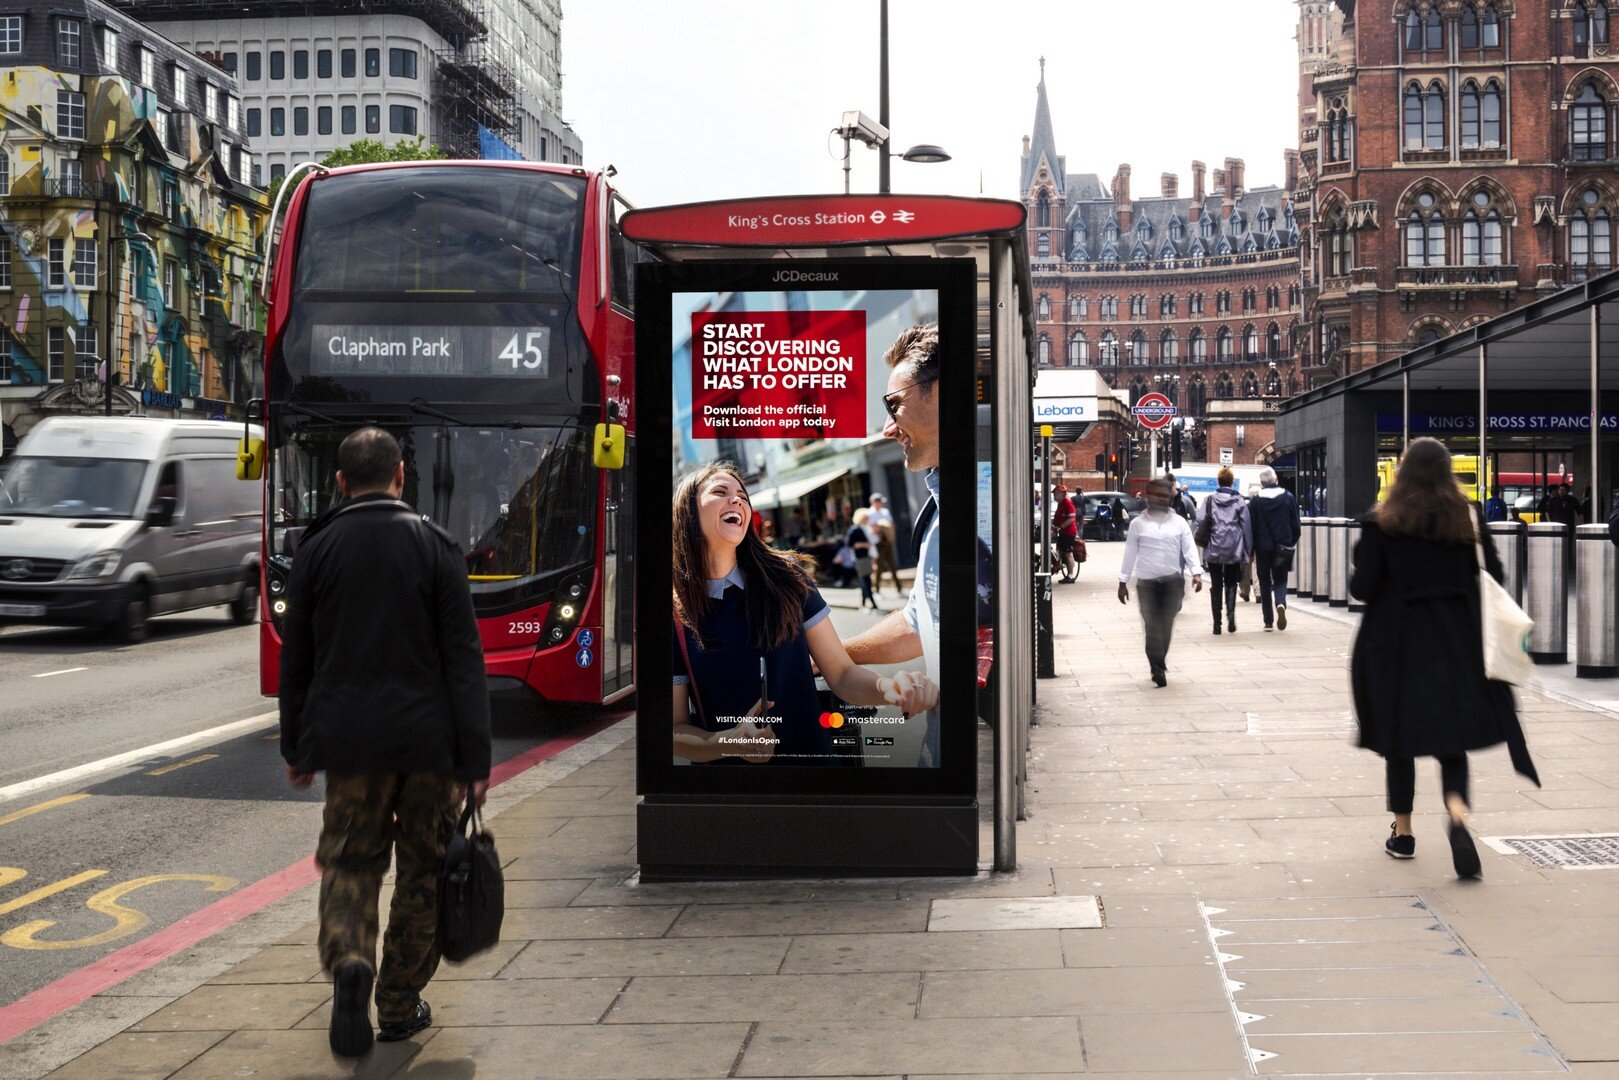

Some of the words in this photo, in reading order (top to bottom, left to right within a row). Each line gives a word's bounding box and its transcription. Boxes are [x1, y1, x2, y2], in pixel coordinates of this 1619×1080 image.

[728, 214, 769, 230] King's
[772, 213, 811, 226] Cross
[815, 211, 865, 225] Station
[772, 270, 839, 283] JCDecaux
[702, 323, 765, 339] START
[328, 336, 406, 361] Clapham
[412, 336, 450, 357] Park
[497, 331, 543, 369] 45
[703, 339, 841, 356] DISCOVERING
[703, 357, 761, 373] WHAT
[767, 356, 853, 372] LONDON
[703, 374, 744, 390] HAS
[750, 374, 777, 390] TO
[781, 373, 846, 389] OFFER
[703, 405, 761, 415] Download
[764, 404, 784, 415] the
[787, 404, 827, 415] official
[1037, 405, 1084, 416] Lebara
[703, 417, 730, 427] Visit
[732, 417, 775, 427] London
[778, 418, 800, 429] app
[803, 417, 836, 428] today
[1428, 415, 1475, 428] KING'S
[1485, 416, 1526, 428] ROSS
[1550, 416, 1618, 428] PANCAS
[508, 621, 541, 634] 2593
[715, 716, 783, 724] VISITLONDON.COM
[848, 716, 905, 724] mastercard
[718, 736, 781, 745] #LondonIsOpen
